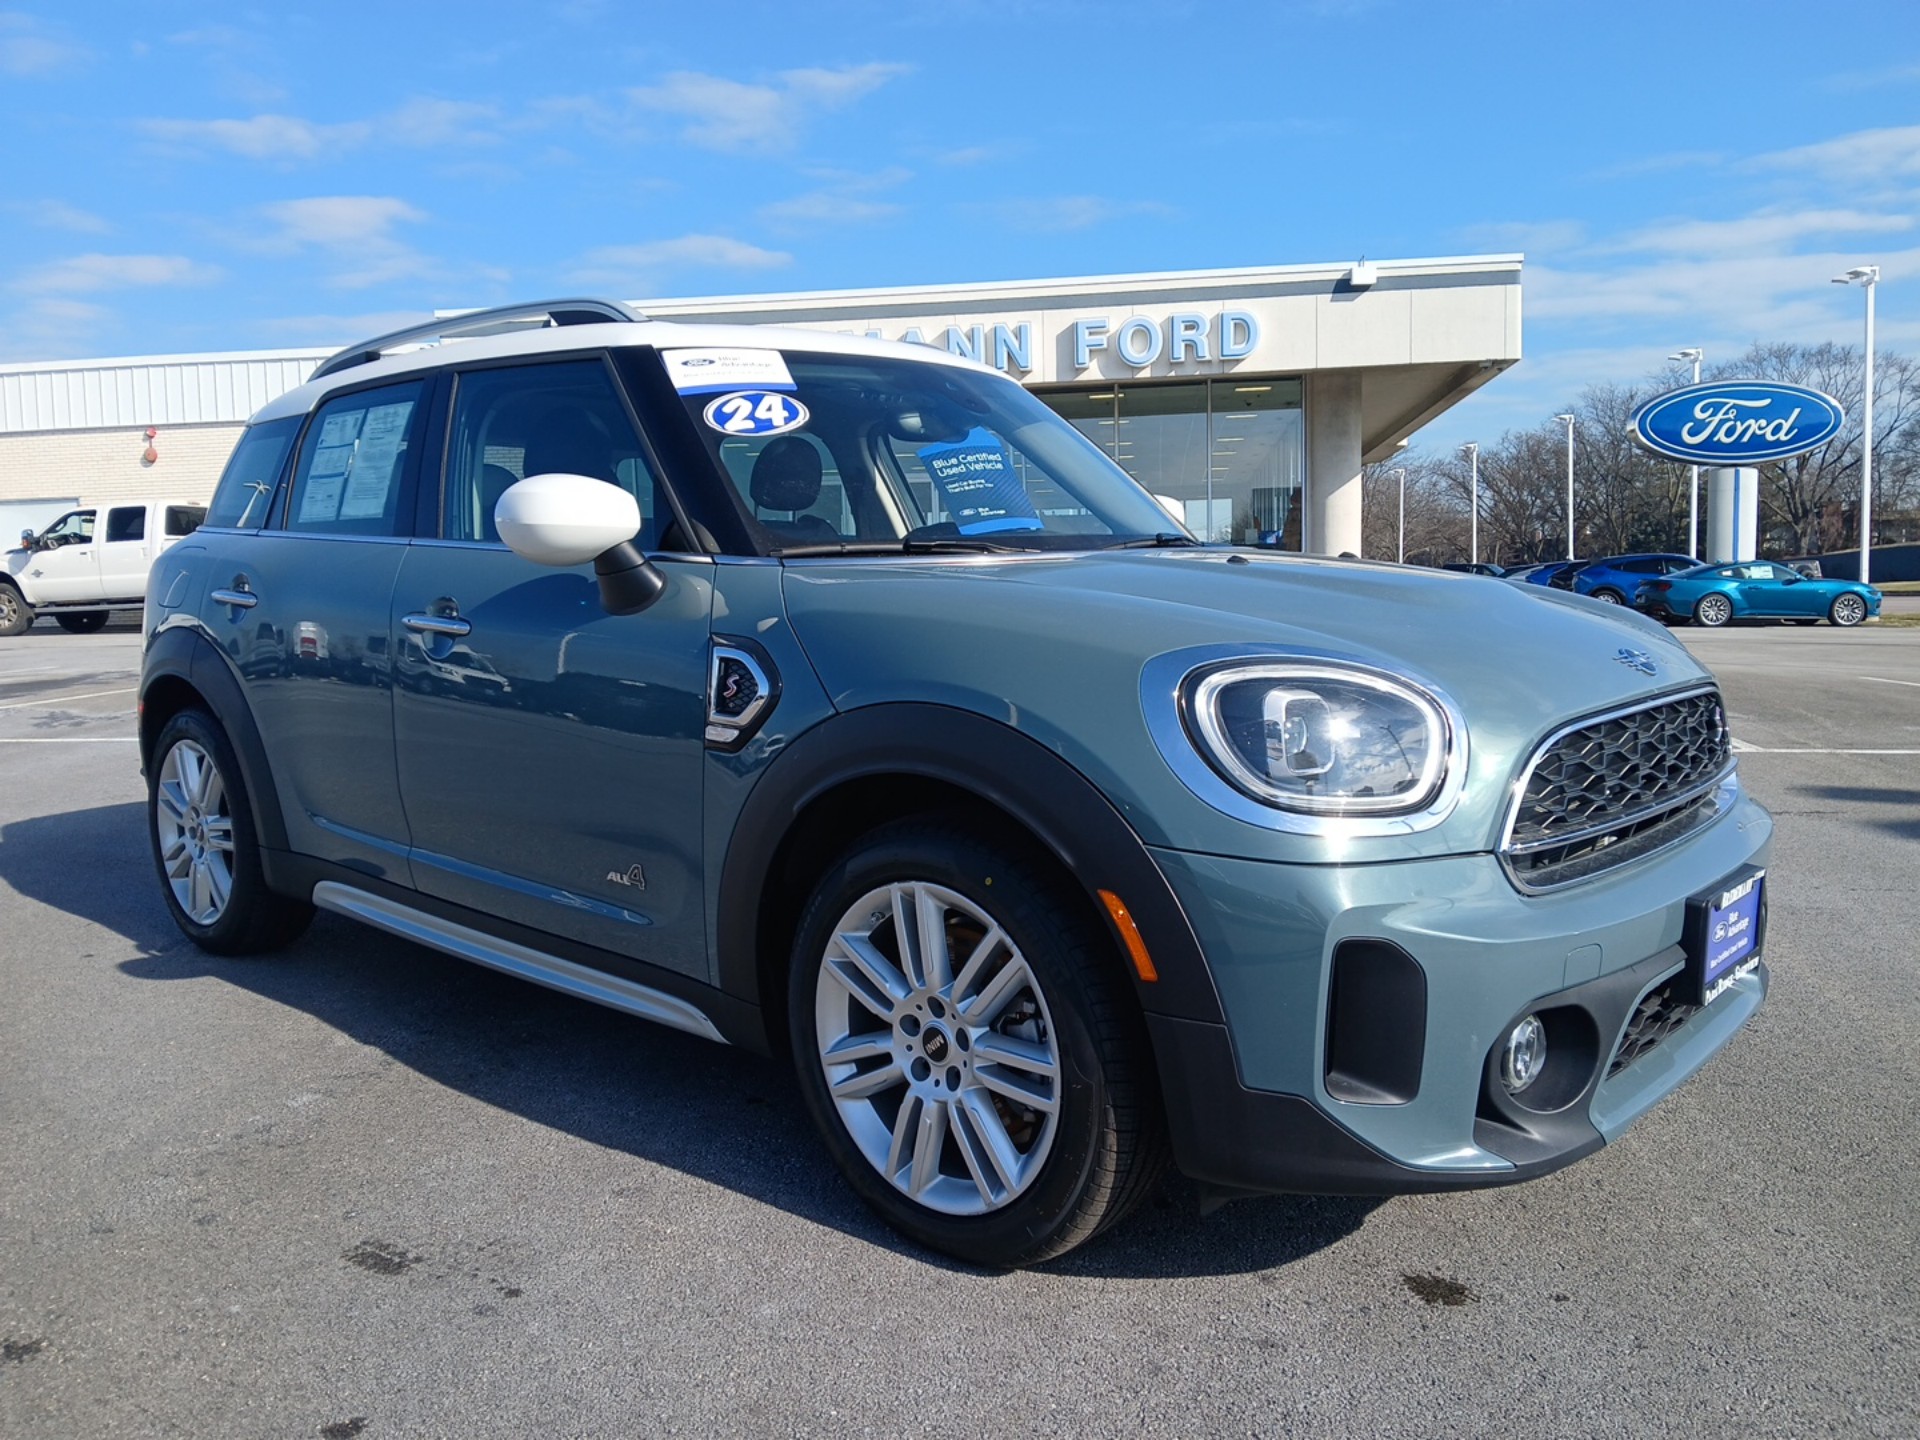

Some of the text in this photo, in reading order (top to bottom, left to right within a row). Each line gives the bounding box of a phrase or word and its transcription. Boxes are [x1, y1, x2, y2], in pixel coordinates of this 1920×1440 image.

[1074, 309, 1261, 369] FORD
[721, 395, 790, 432] 24
[1681, 398, 1802, 445] Ford
[932, 452, 1002, 469] Blue Certified
[937, 461, 1004, 477] Used Vehicle
[925, 1034, 945, 1055] MINI
